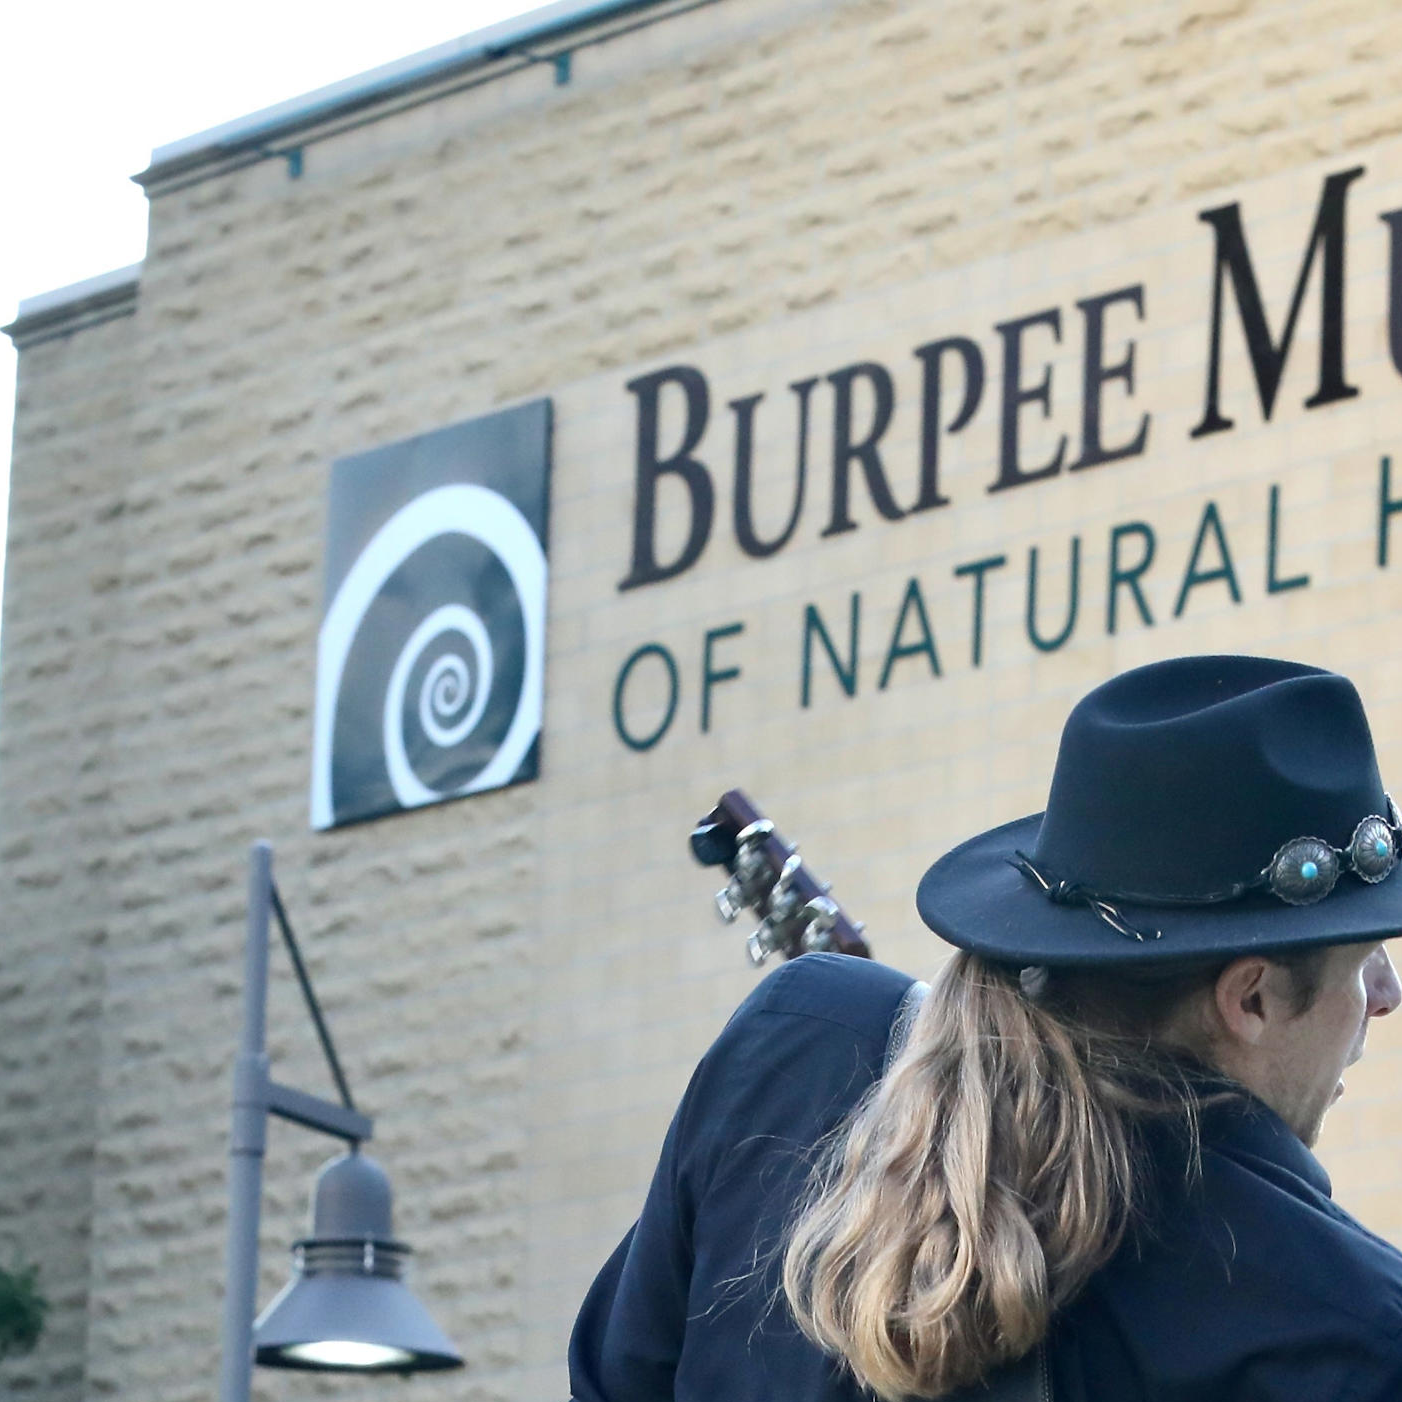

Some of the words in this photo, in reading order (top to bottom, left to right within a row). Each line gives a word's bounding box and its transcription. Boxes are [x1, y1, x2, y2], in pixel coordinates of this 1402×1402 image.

[618, 282, 1151, 593] BURPEE
[612, 620, 745, 753] OF
[800, 484, 1311, 709] NATURAL
